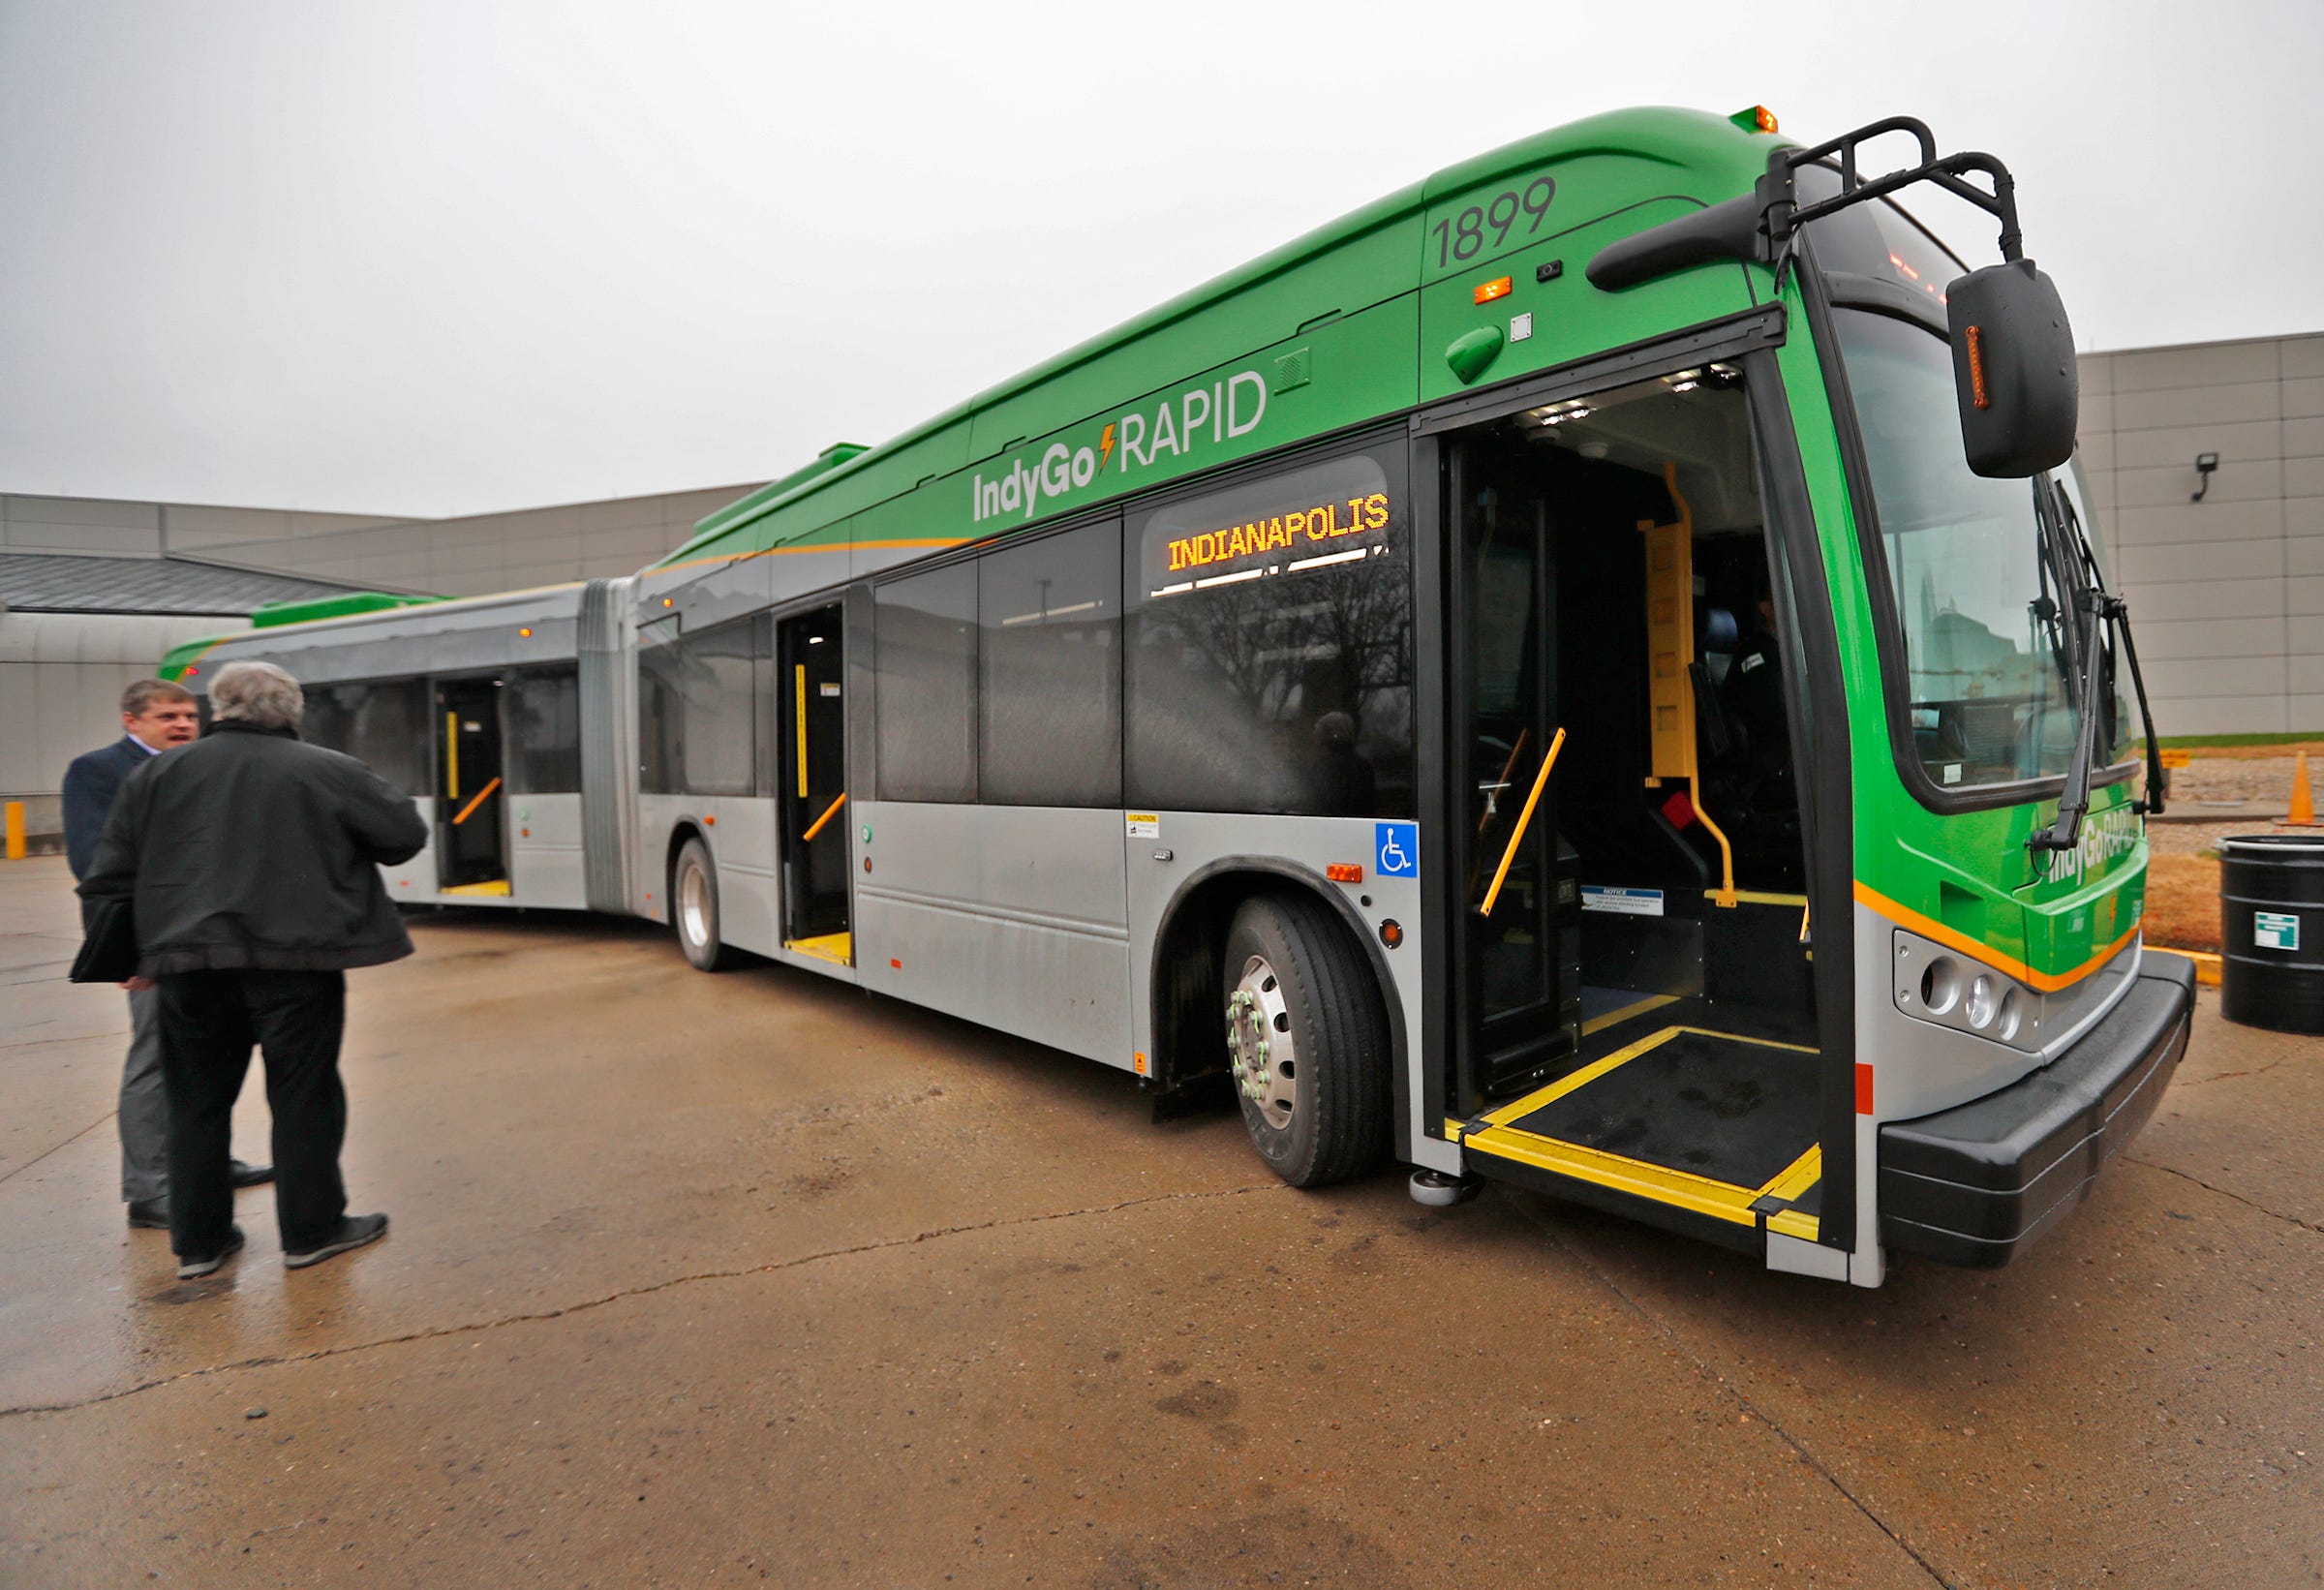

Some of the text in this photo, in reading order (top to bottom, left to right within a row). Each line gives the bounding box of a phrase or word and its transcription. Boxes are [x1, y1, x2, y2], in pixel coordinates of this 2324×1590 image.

[1432, 175, 1556, 268] 1899
[973, 370, 1267, 522] IndyGo RAPID
[1168, 493, 1390, 571] INDIANAPOLIS
[1133, 813, 1156, 822] CAUTION
